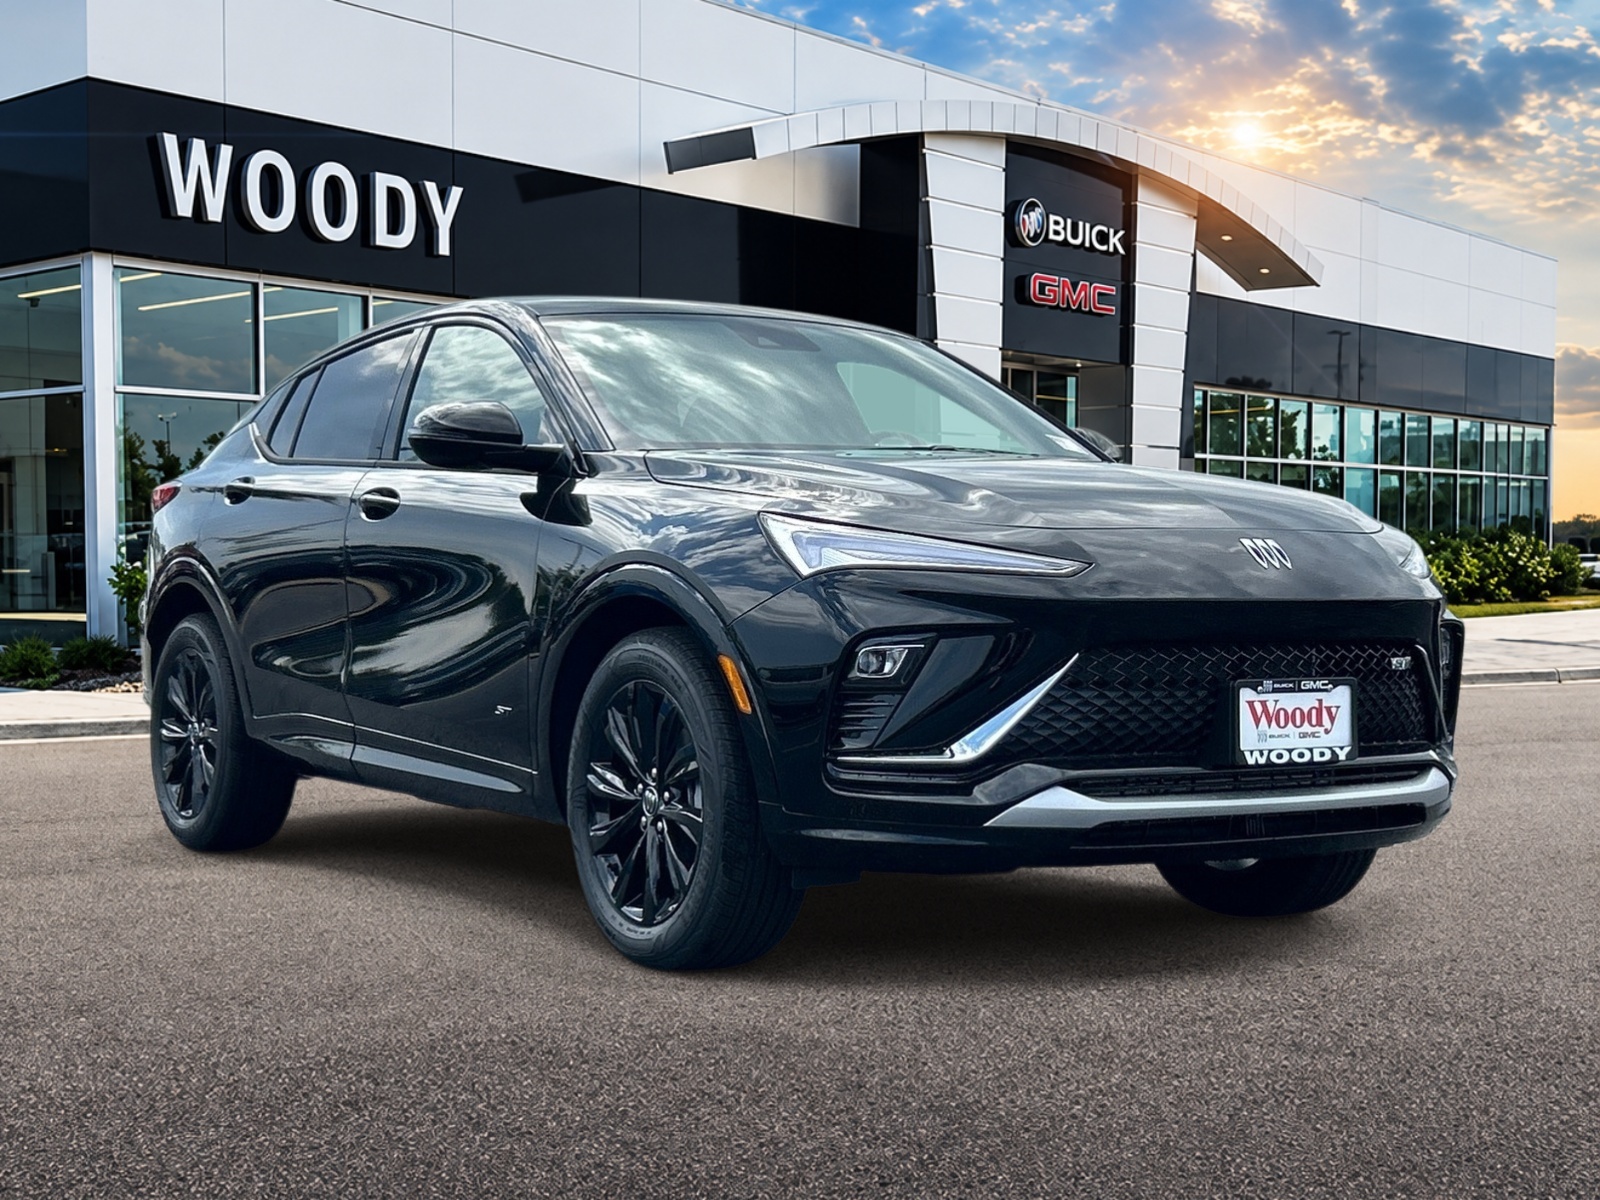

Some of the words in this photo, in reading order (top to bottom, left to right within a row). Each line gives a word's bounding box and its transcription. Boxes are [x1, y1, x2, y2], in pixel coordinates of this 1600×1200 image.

[157, 131, 464, 257] WOODY
[1047, 213, 1126, 256] BUICK
[1030, 272, 1117, 316] GMC
[1300, 680, 1330, 690] GMC
[1245, 698, 1341, 735] Woody
[1298, 731, 1322, 739] GMC
[1243, 746, 1352, 765] WOODY
